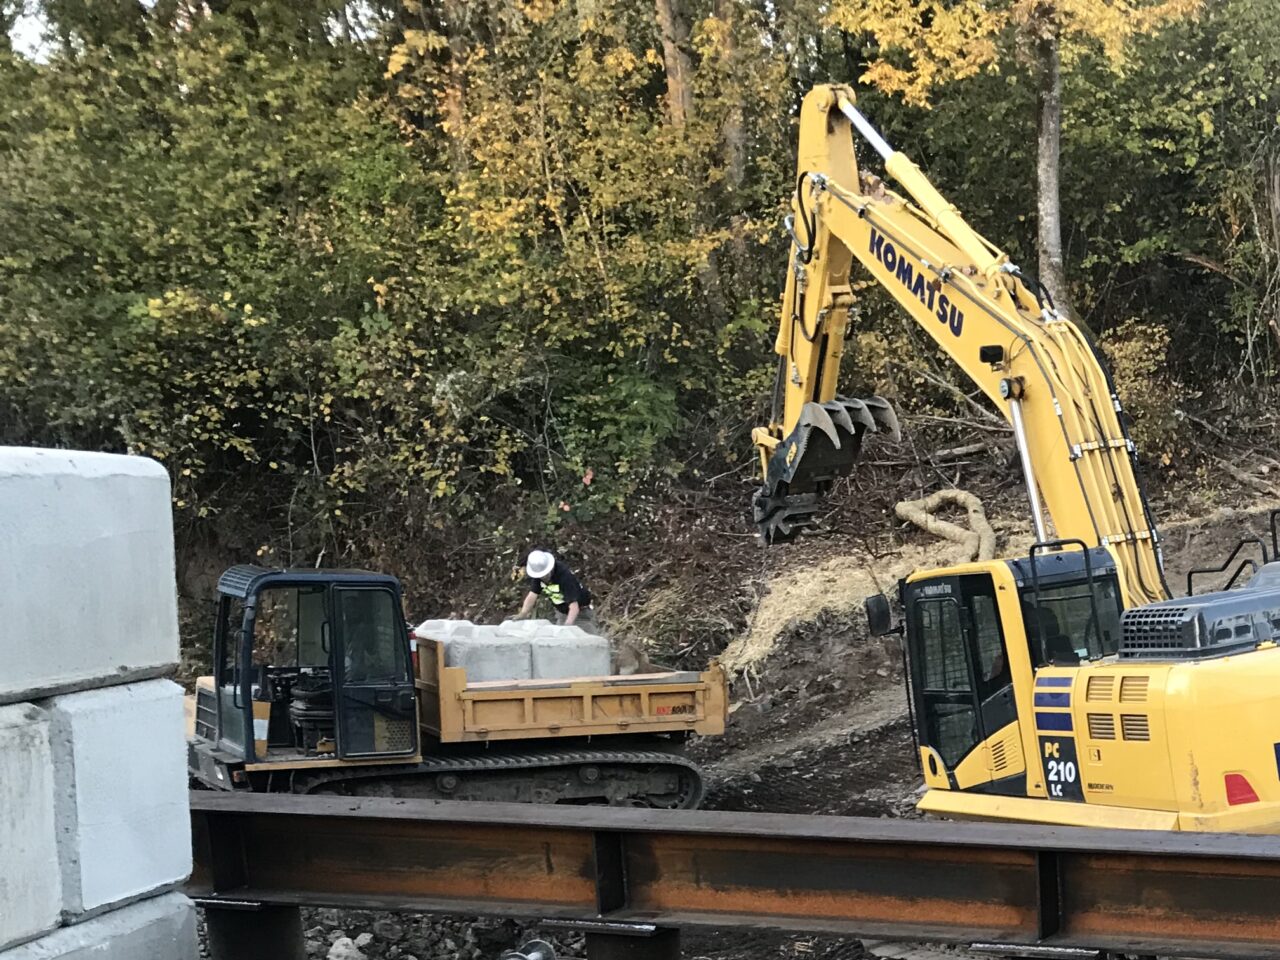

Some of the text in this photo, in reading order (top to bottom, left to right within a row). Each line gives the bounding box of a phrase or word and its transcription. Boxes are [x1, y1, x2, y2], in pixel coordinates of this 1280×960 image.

[869, 226, 964, 337] KOMATSU
[1044, 742, 1060, 758] PC
[1047, 760, 1076, 783] 210
[1051, 783, 1063, 796] LC
